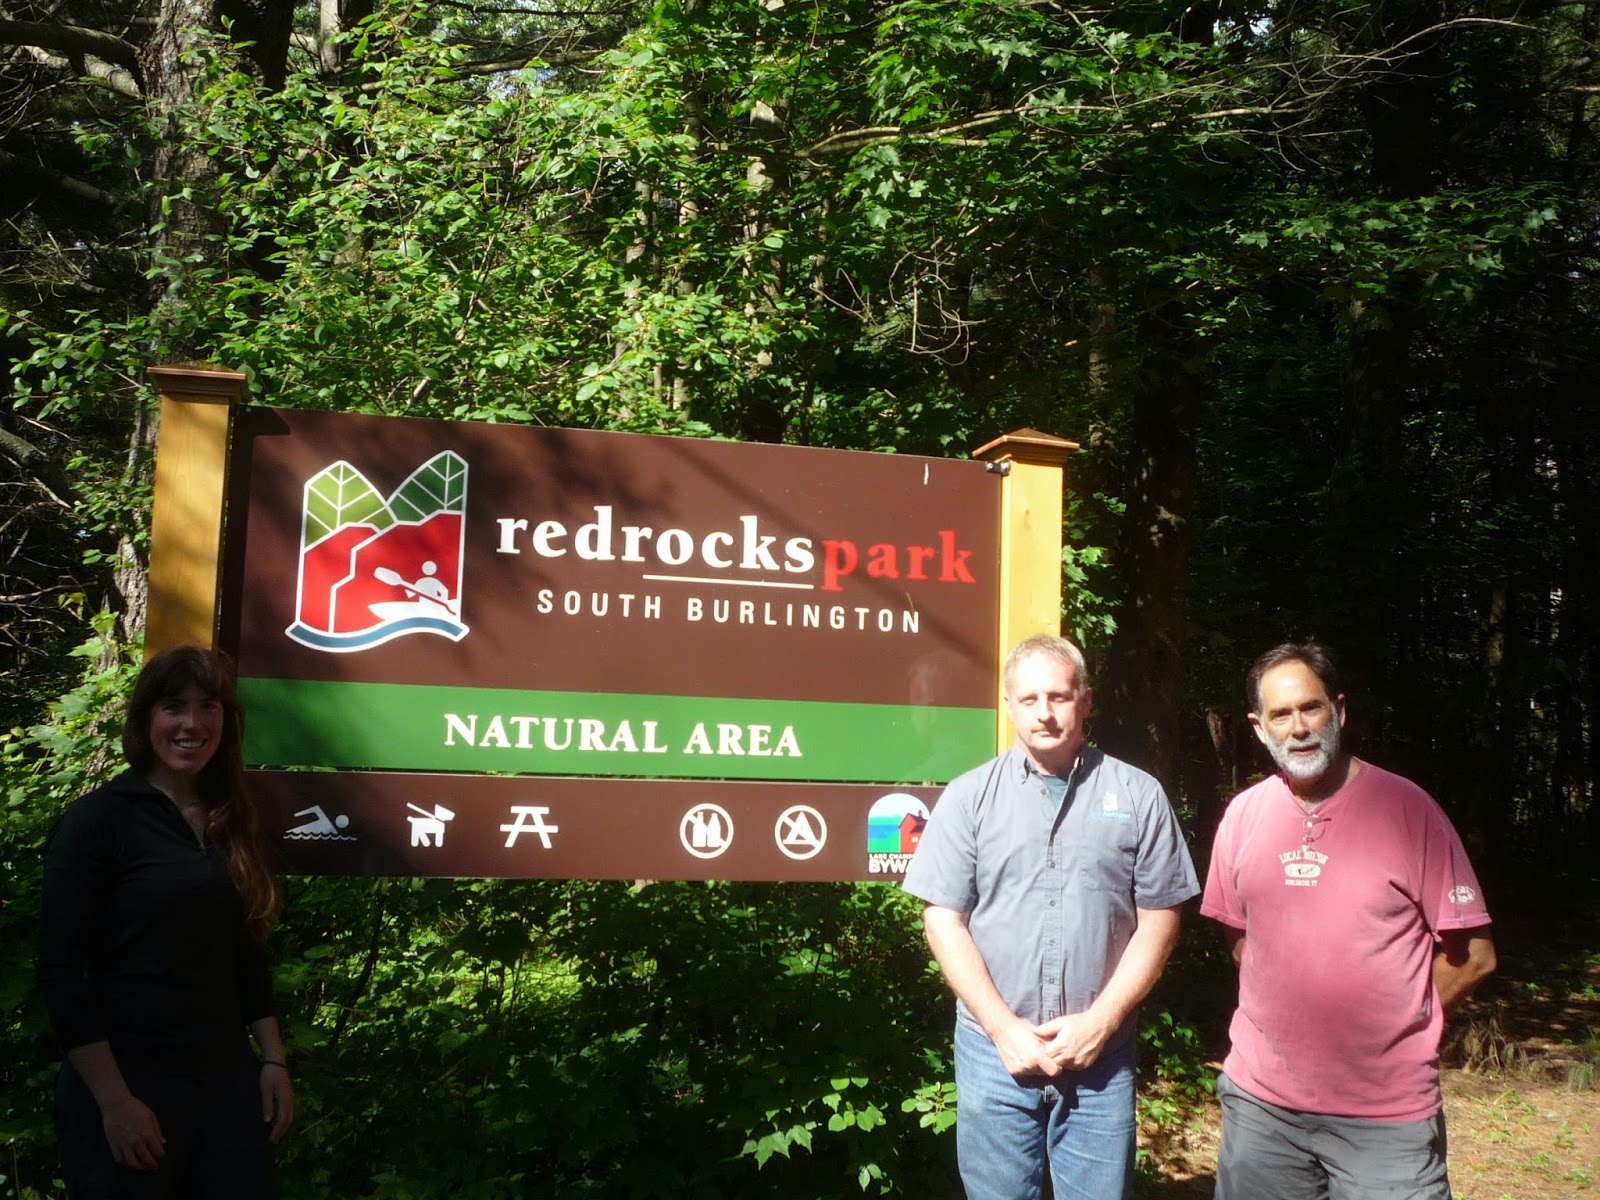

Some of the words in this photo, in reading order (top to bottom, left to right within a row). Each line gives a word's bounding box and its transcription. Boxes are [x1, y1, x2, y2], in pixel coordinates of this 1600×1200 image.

[537, 589, 661, 619] SOUTH
[687, 598, 919, 634] BURLINGTON
[443, 713, 669, 755] NATURAL
[683, 722, 803, 758] AREA
[1279, 850, 1302, 864] LOCAL
